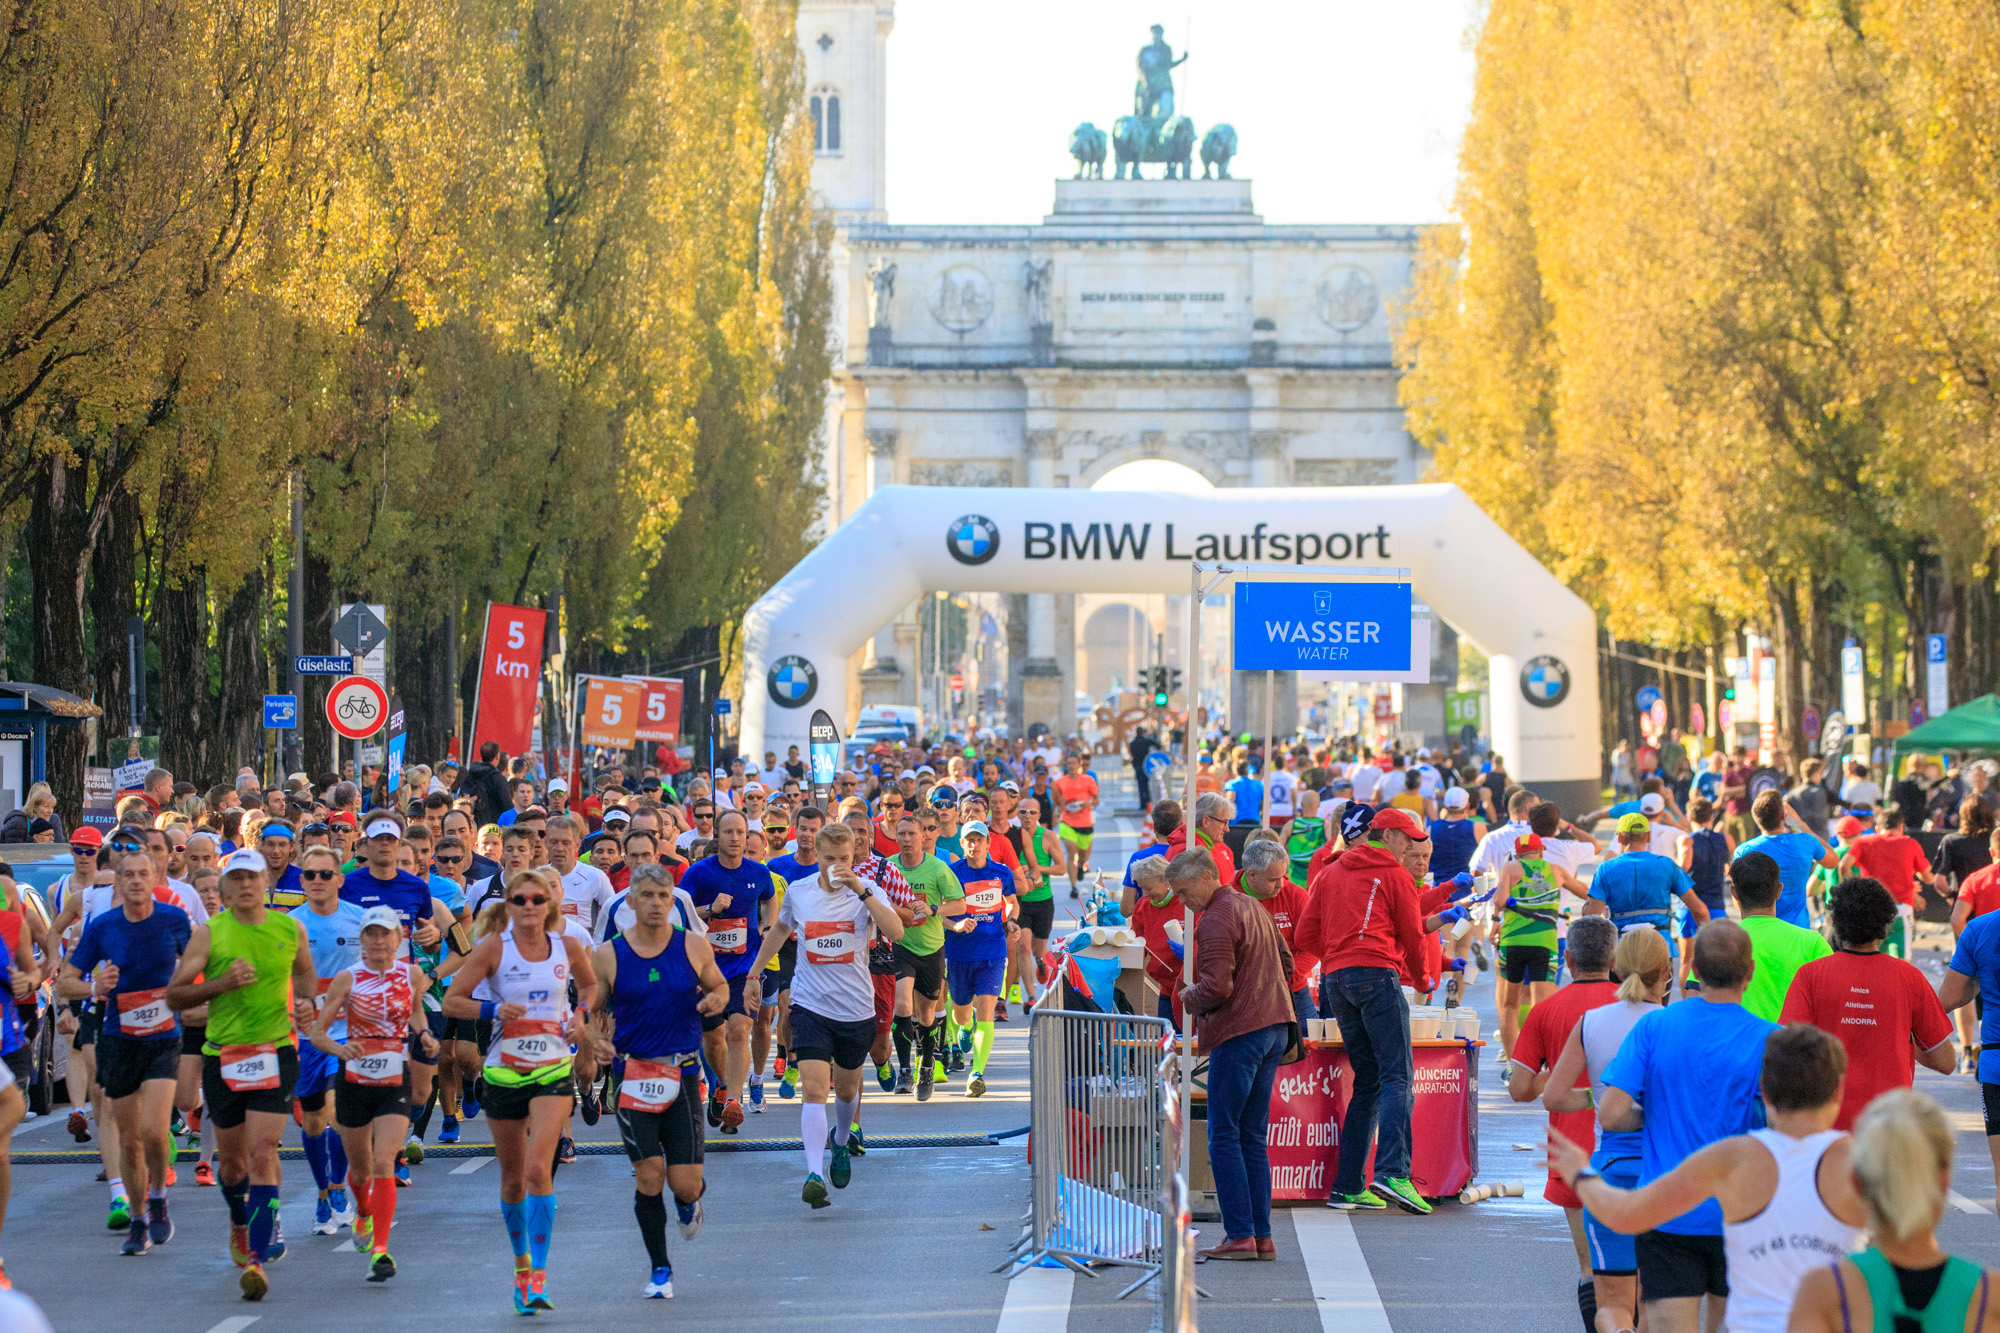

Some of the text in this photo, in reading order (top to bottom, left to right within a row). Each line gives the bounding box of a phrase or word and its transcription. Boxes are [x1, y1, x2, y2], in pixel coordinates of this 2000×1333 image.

[1023, 522, 1391, 566] BMW Laufsport
[507, 620, 525, 649] 5
[1265, 620, 1381, 644] WASSER
[1297, 646, 1349, 661] WATER
[298, 658, 351, 672] Giselastr.
[495, 653, 529, 679] km
[602, 694, 622, 725] 5
[646, 692, 666, 722] 5
[1451, 698, 1477, 720] 16
[635, 729, 674, 741] MARATHON
[818, 725, 833, 741] cep
[812, 753, 834, 774] 3:14
[975, 893, 994, 902] 5129
[716, 933, 738, 942] 2815
[817, 938, 843, 949] 6260
[1850, 986, 1870, 995] Amics
[1845, 1001, 1875, 1010] Atletisme
[132, 1007, 159, 1021] 3827
[1840, 1017, 1877, 1026] ANDORRA
[517, 1039, 547, 1052] 2470
[236, 1060, 264, 1073] 2298
[360, 1058, 389, 1069] 2297
[1413, 1066, 1460, 1081] MÜNCHEN
[638, 1082, 665, 1095] 1510
[1411, 1081, 1460, 1094] MARATHON
[1306, 1115, 1339, 1147] euch
[1269, 1159, 1325, 1190] nmarkt
[1789, 1233, 1847, 1257] COBUR
